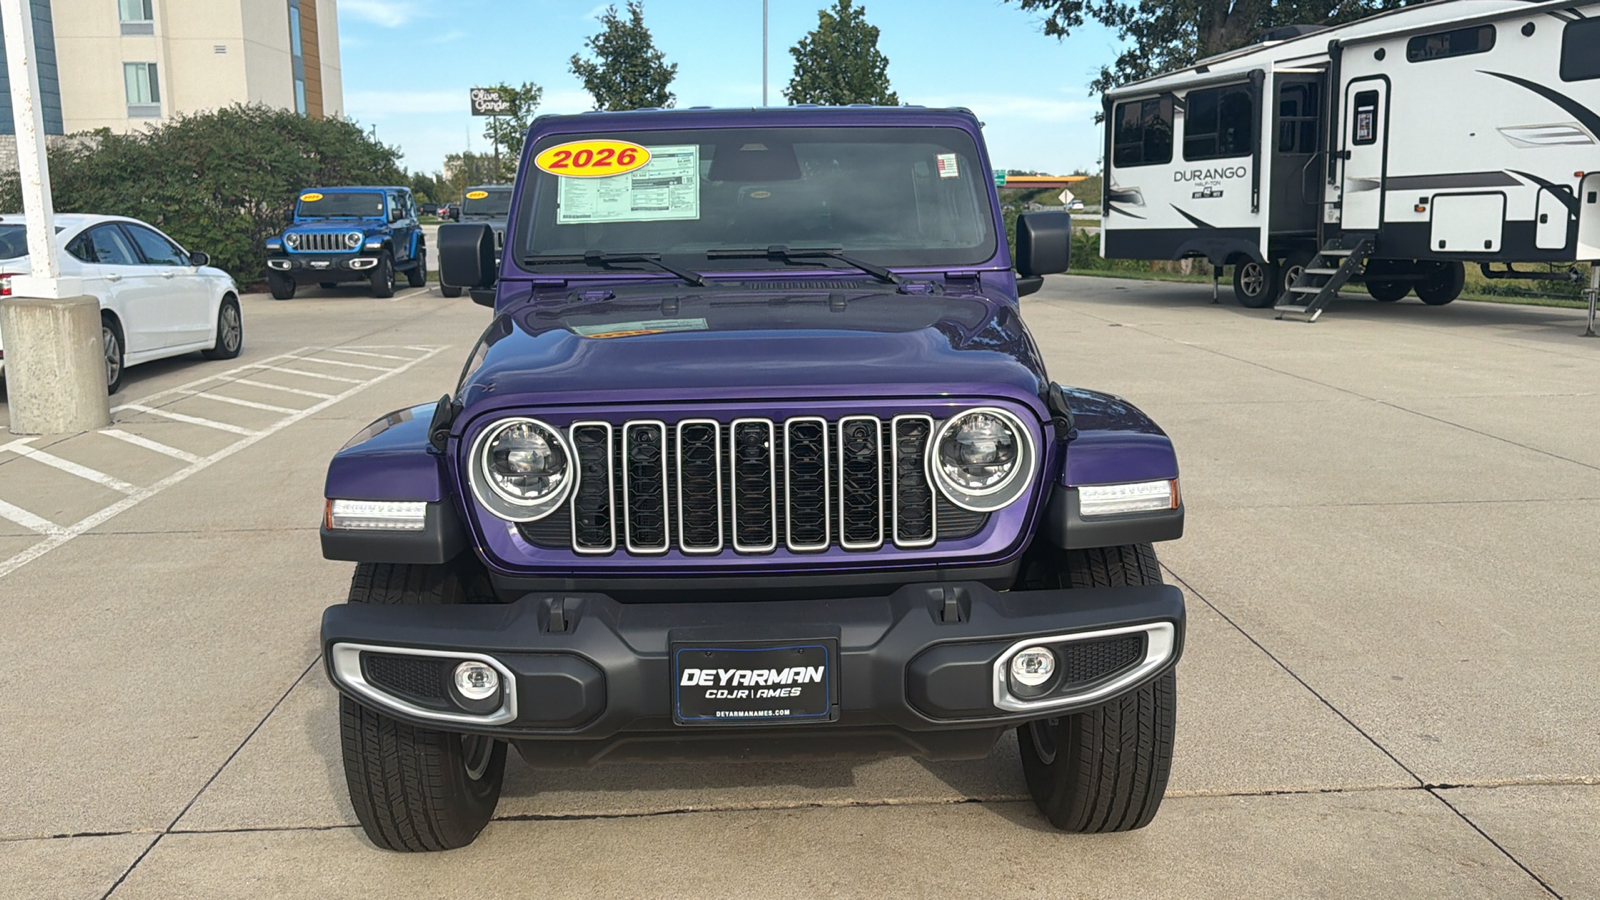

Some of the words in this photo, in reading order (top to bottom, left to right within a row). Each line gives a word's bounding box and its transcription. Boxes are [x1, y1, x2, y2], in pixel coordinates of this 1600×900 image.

[471, 89, 499, 101] Olive
[549, 148, 639, 169] 2026
[1174, 166, 1247, 182] DURANGO
[680, 666, 825, 686] DEYARMAN
[705, 689, 749, 699] CDJR
[756, 687, 802, 698] AMES
[716, 709, 790, 717] DEYARMANAMES.COM
